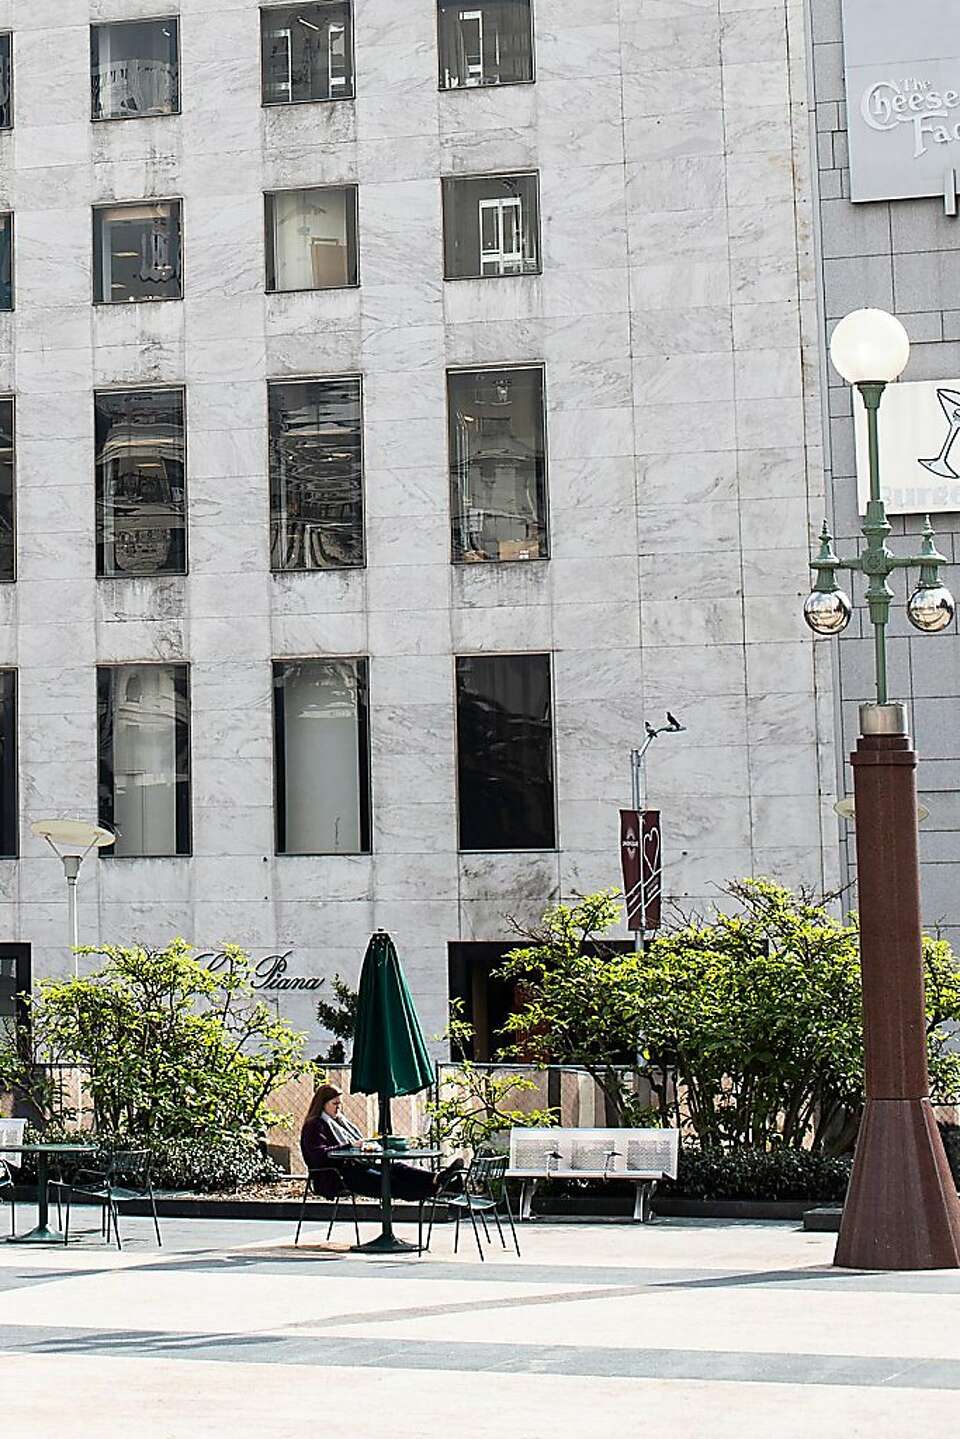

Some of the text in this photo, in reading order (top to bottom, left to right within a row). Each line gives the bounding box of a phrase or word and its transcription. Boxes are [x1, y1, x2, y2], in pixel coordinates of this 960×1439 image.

[861, 81, 960, 131] Cheese
[900, 78, 931, 92] The
[250, 949, 326, 991] Piana
